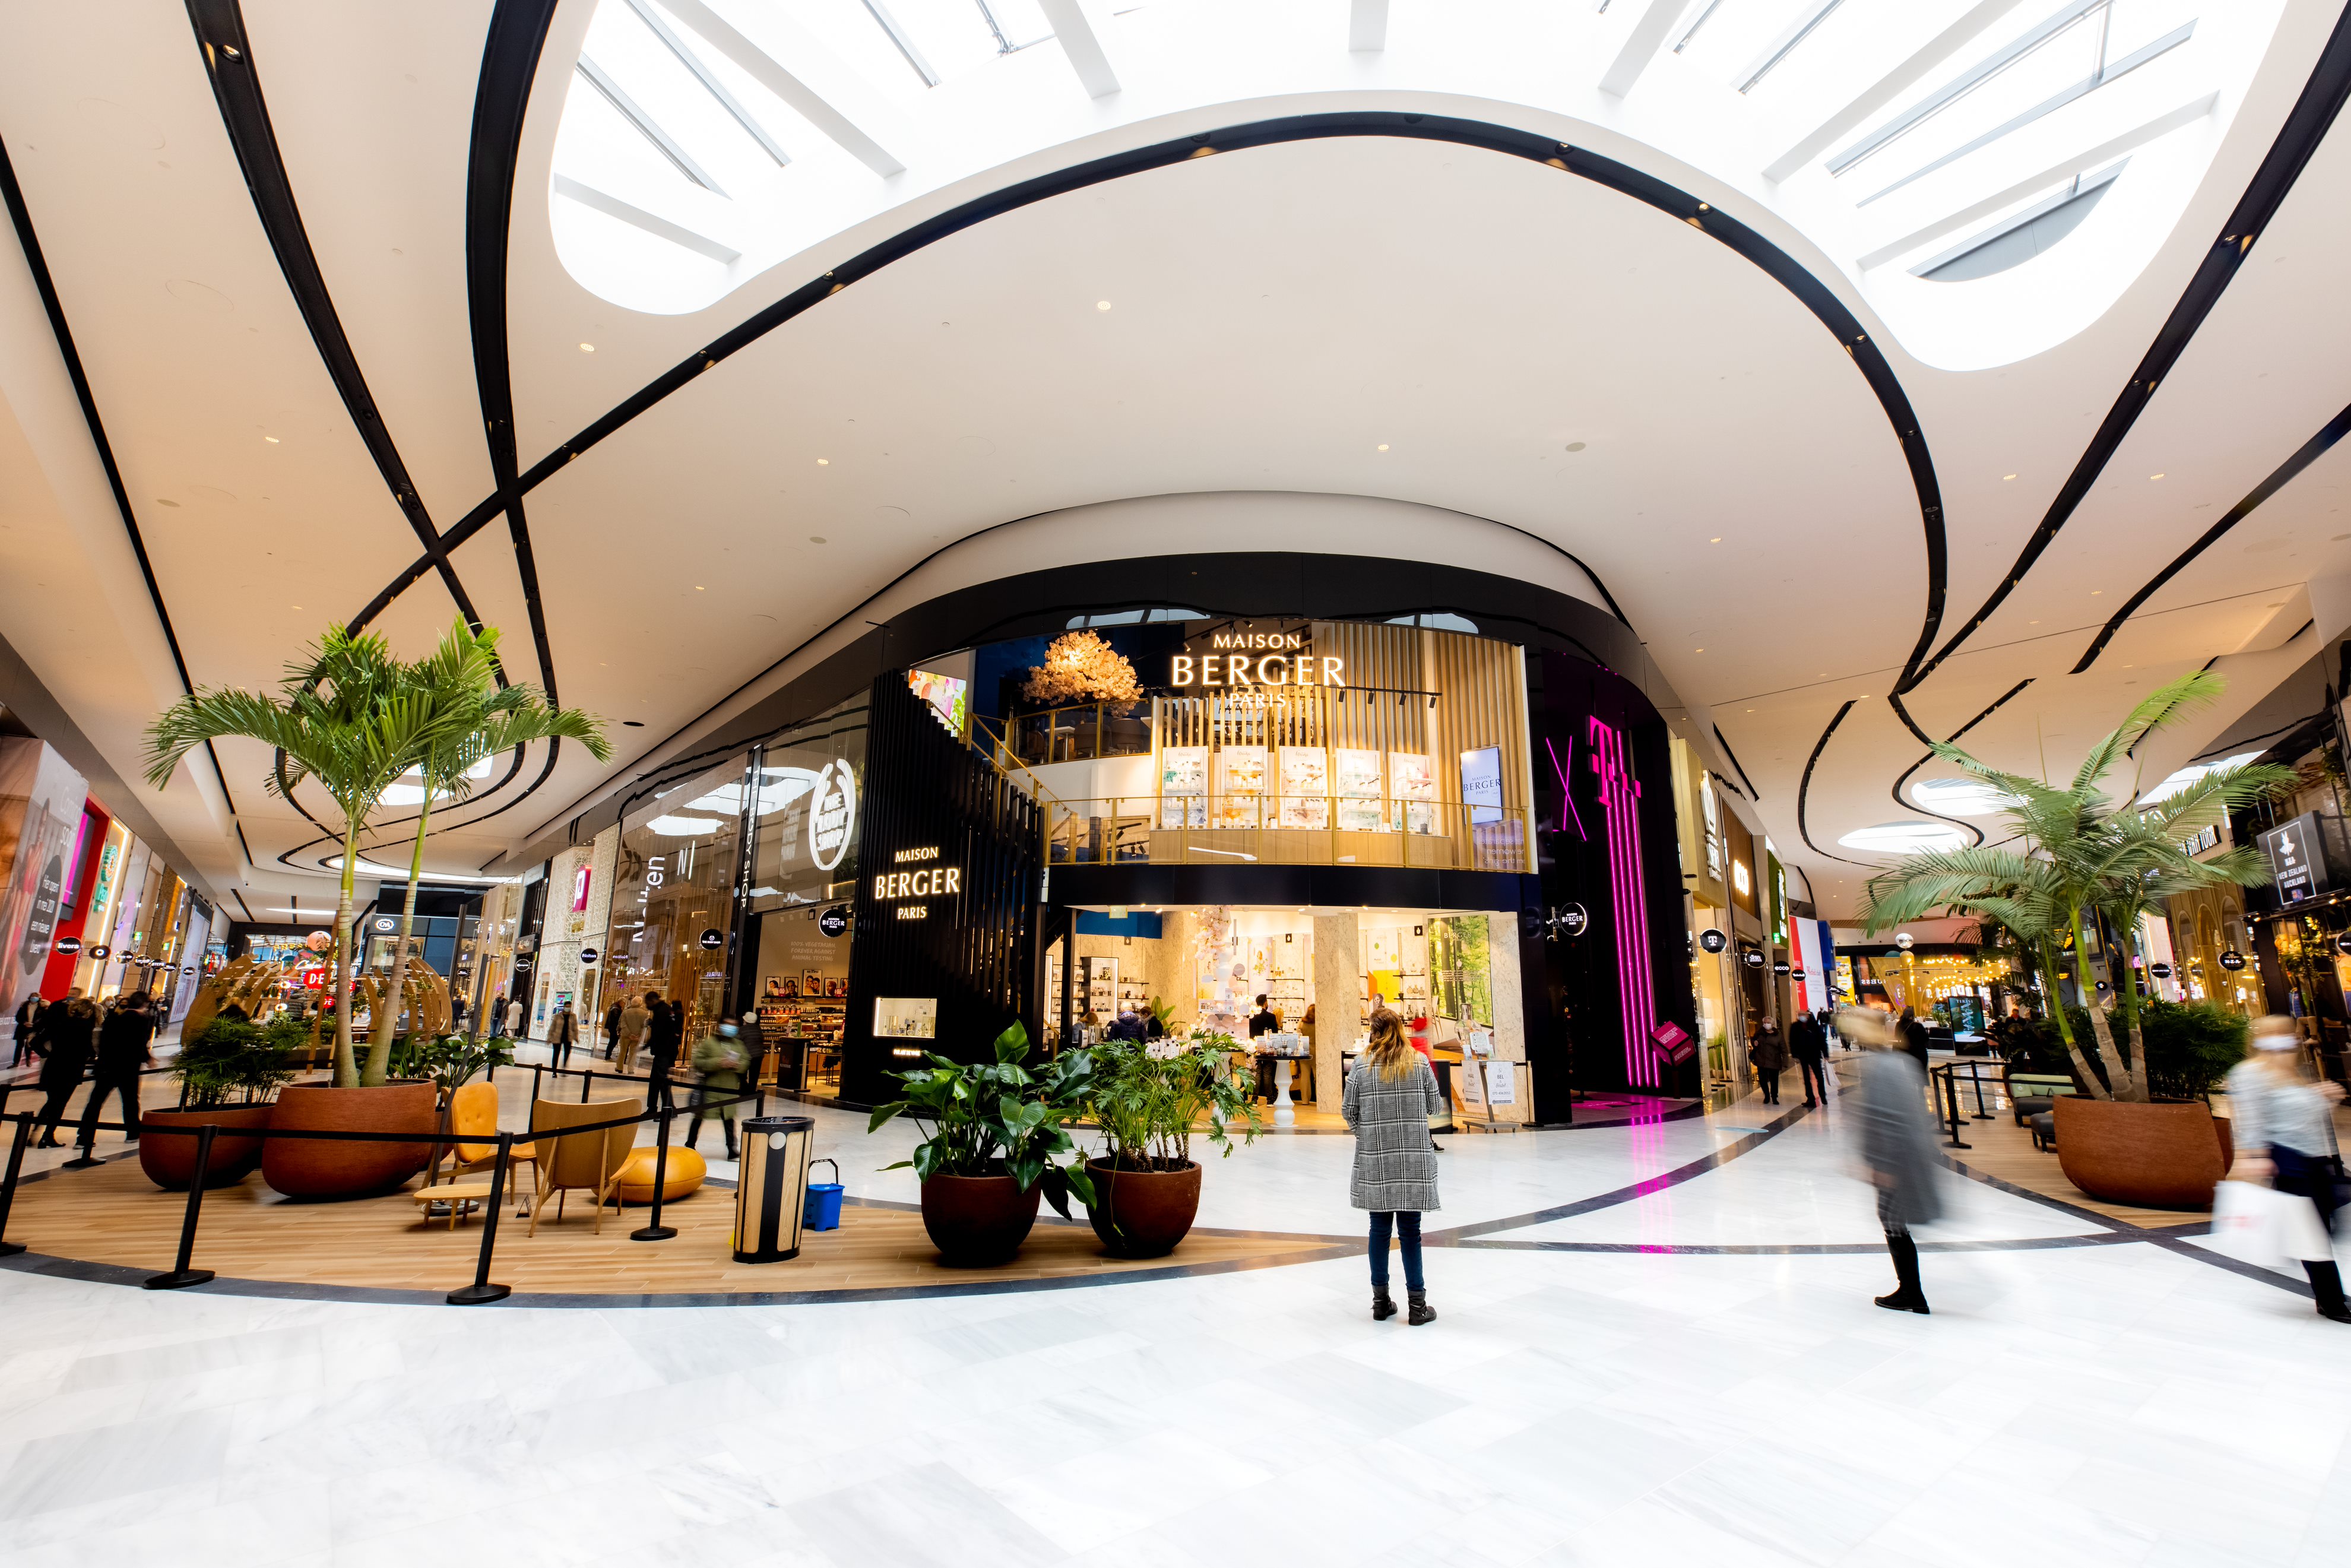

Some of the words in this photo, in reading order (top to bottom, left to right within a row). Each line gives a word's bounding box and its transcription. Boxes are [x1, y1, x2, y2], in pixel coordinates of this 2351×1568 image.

[1213, 634, 1300, 649] MAISON
[1172, 655, 1346, 687] BERGER
[1230, 693, 1287, 708] PARIS
[750, 765, 761, 800] THE
[1463, 779, 1501, 791] BERGER
[745, 809, 755, 856] BODY
[895, 847, 939, 862] MAISON
[2278, 871, 2288, 880] NEW
[2287, 864, 2308, 877] ZEALAND
[741, 860, 750, 908] SHOP
[875, 868, 960, 899] BERGER
[2283, 876, 2306, 888] AUCKLAND
[898, 906, 927, 920] PARIS
